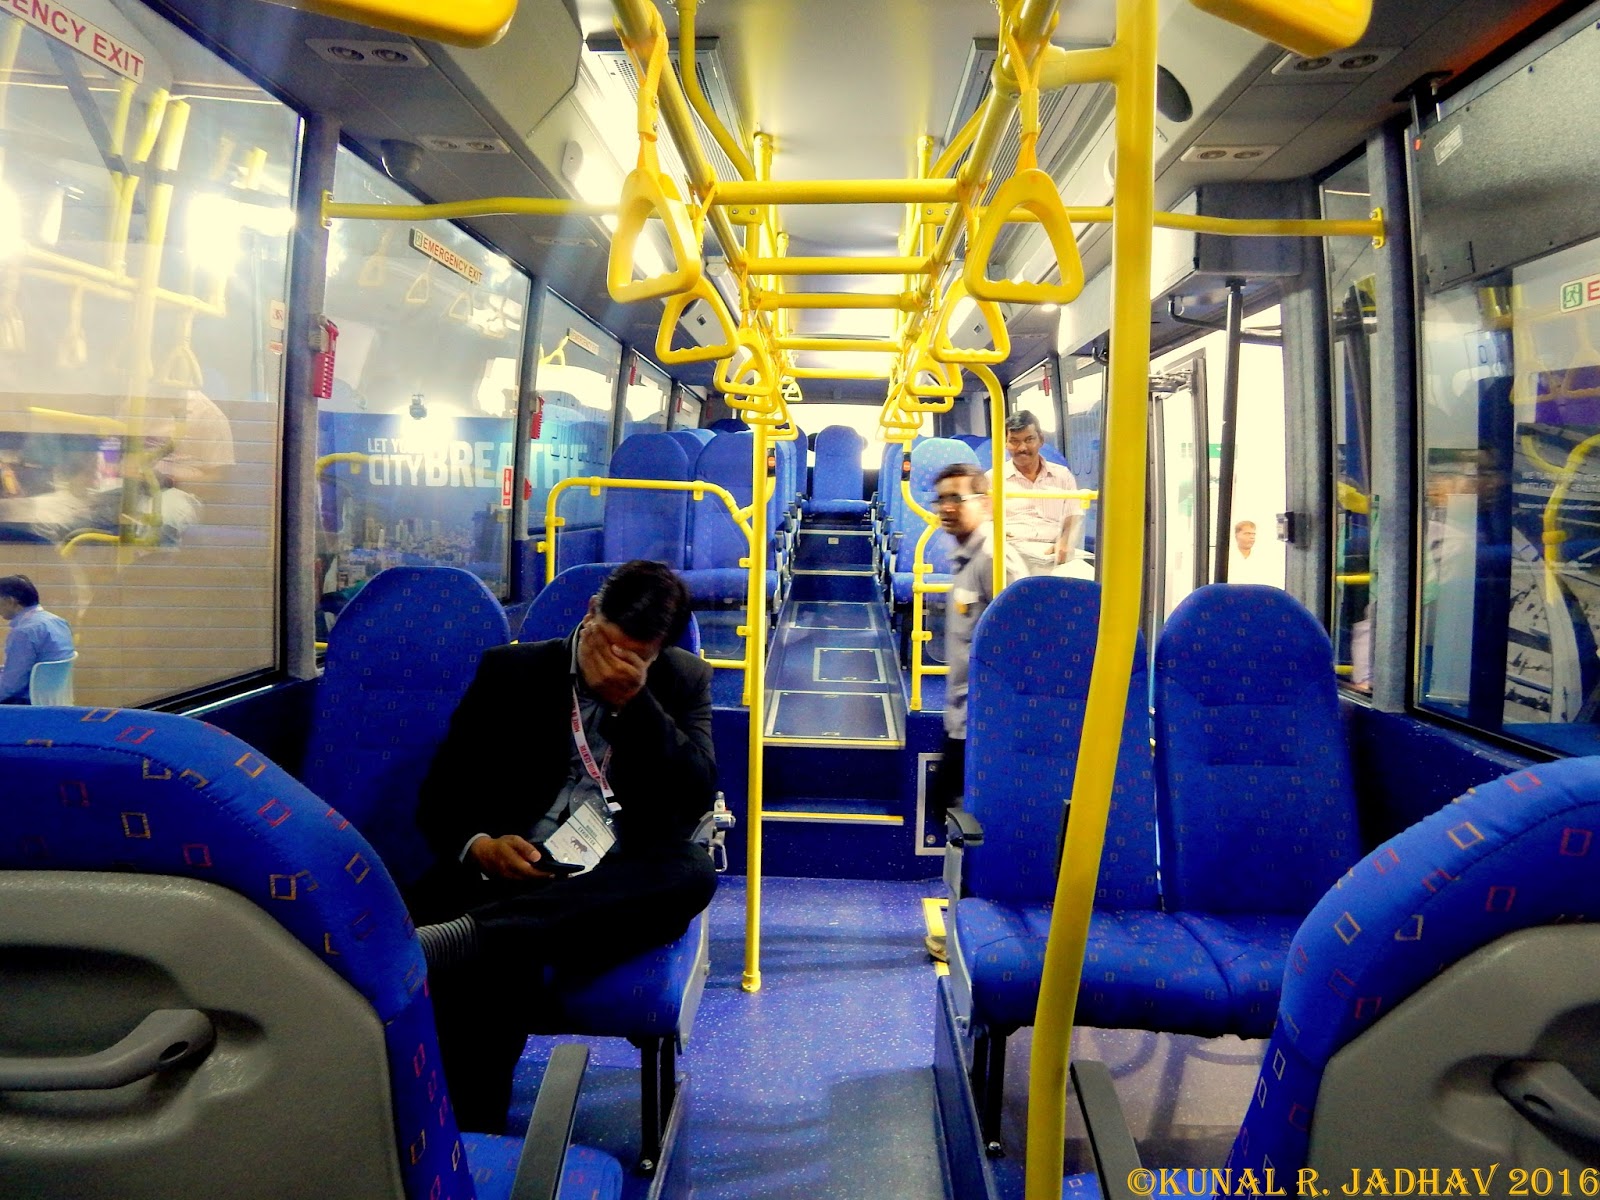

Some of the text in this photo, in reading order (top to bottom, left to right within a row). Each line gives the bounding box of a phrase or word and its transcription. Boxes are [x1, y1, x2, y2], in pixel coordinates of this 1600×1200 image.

[1, 0, 144, 77] ENCY EXIT
[422, 237, 483, 282] EMERGENCY EXIT
[367, 437, 388, 453] LET
[368, 453, 425, 486] CITY
